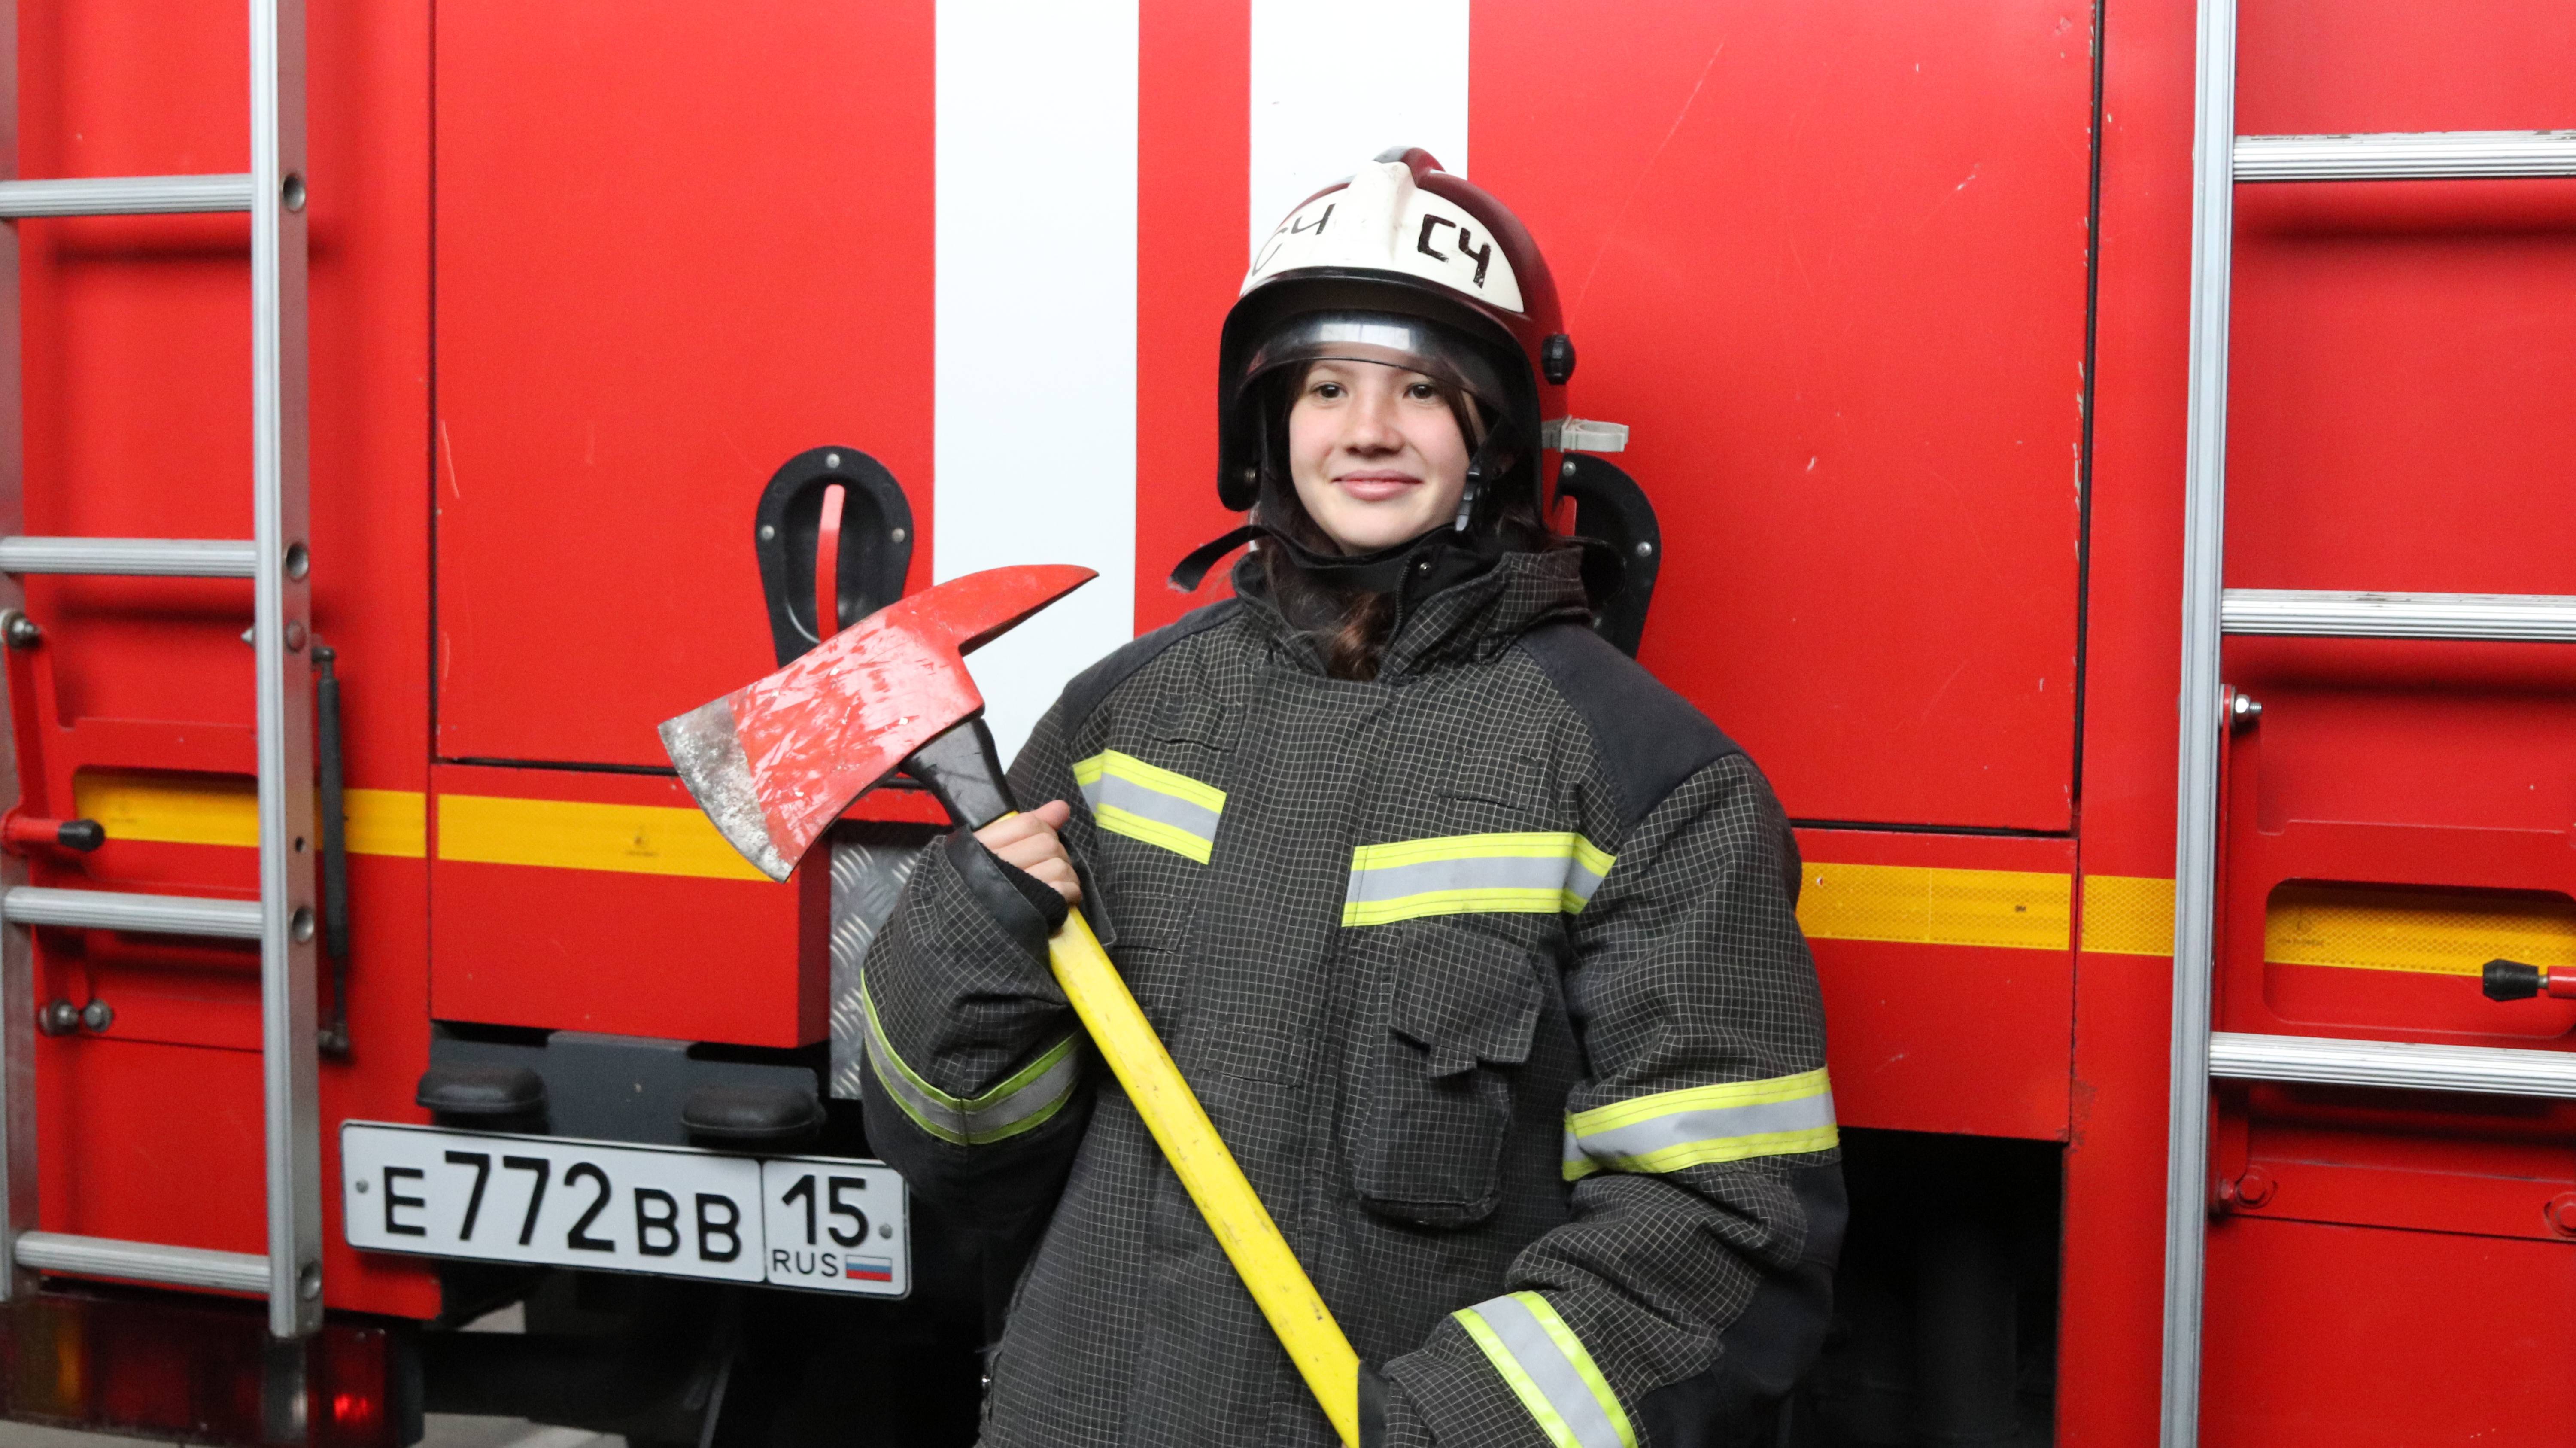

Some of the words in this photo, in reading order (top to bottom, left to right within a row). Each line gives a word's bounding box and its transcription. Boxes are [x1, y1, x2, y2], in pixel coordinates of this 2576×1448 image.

[383, 1150, 743, 1263] E772BB
[782, 1174, 869, 1248] 15
[773, 1249, 838, 1278] RUS
